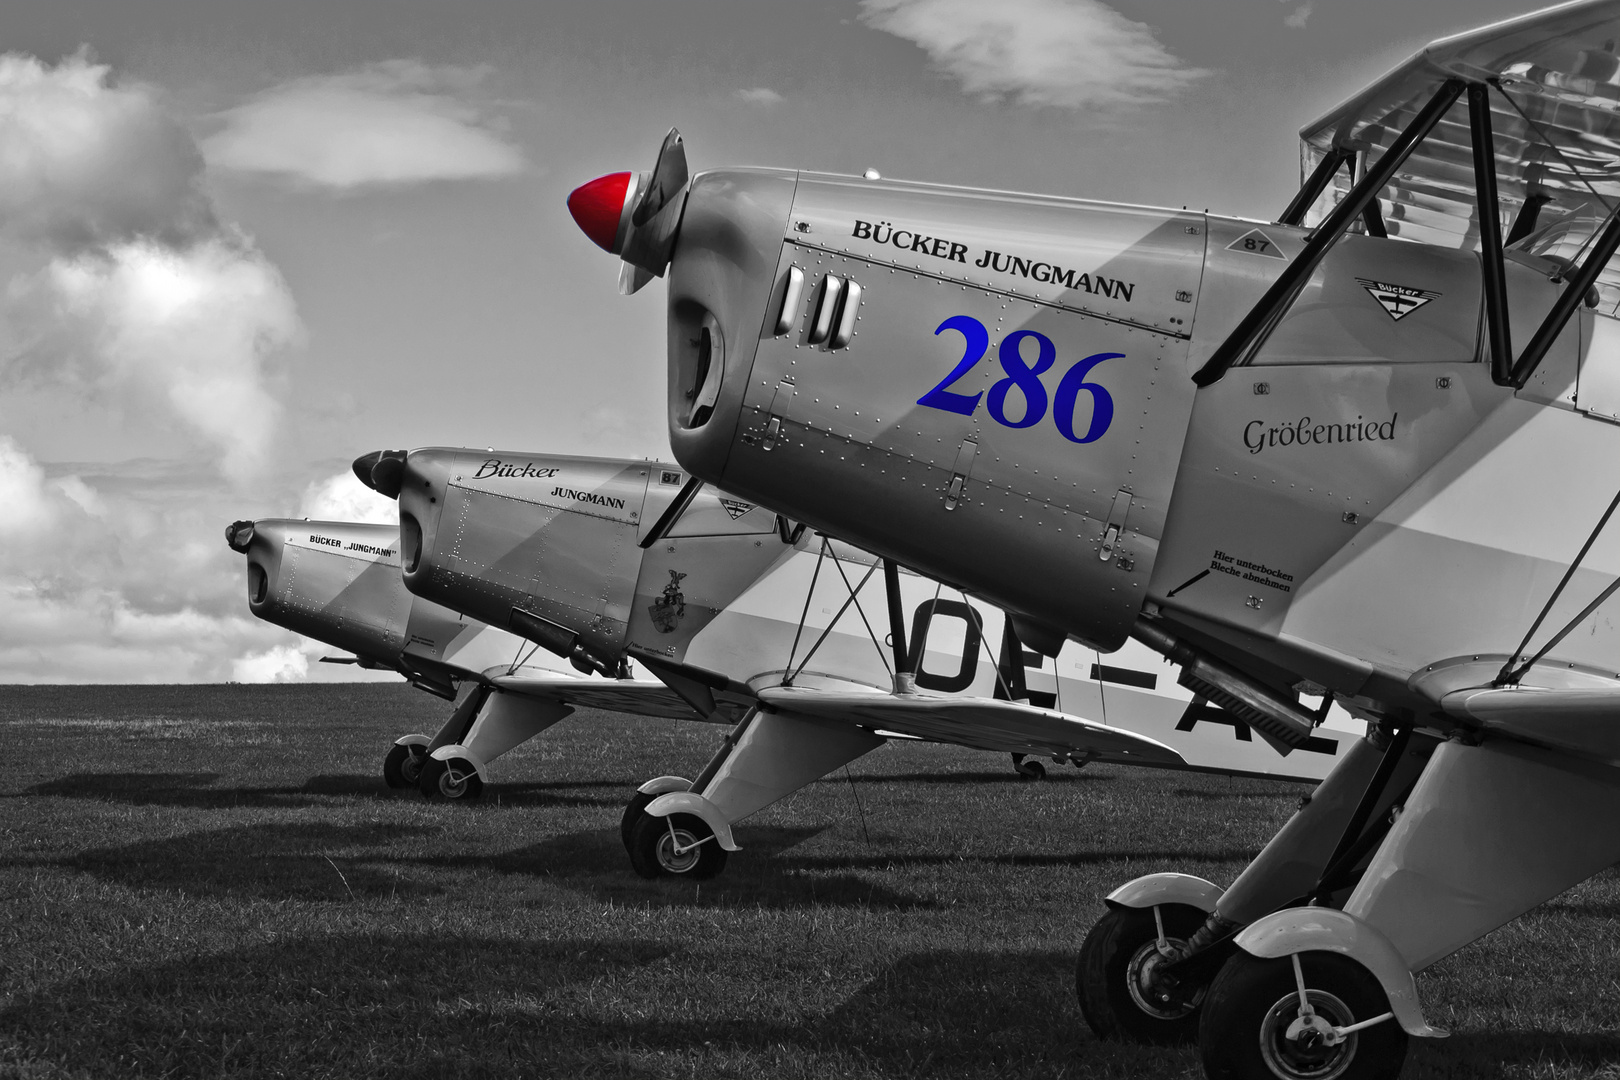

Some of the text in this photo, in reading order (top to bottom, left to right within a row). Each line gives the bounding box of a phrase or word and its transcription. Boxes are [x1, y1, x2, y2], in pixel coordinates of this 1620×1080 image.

[1244, 237, 1270, 253] 87
[851, 219, 1135, 303] BÜCKER JUNGMANN
[916, 315, 1126, 444] 286
[472, 458, 560, 480] Bücker
[662, 472, 681, 483] 87
[550, 486, 625, 510] JUNGMANN
[309, 534, 342, 548] BÜCKER
[1209, 560, 1291, 592] Bleche abnehmen
[1213, 550, 1294, 582] Hier unterbocken
